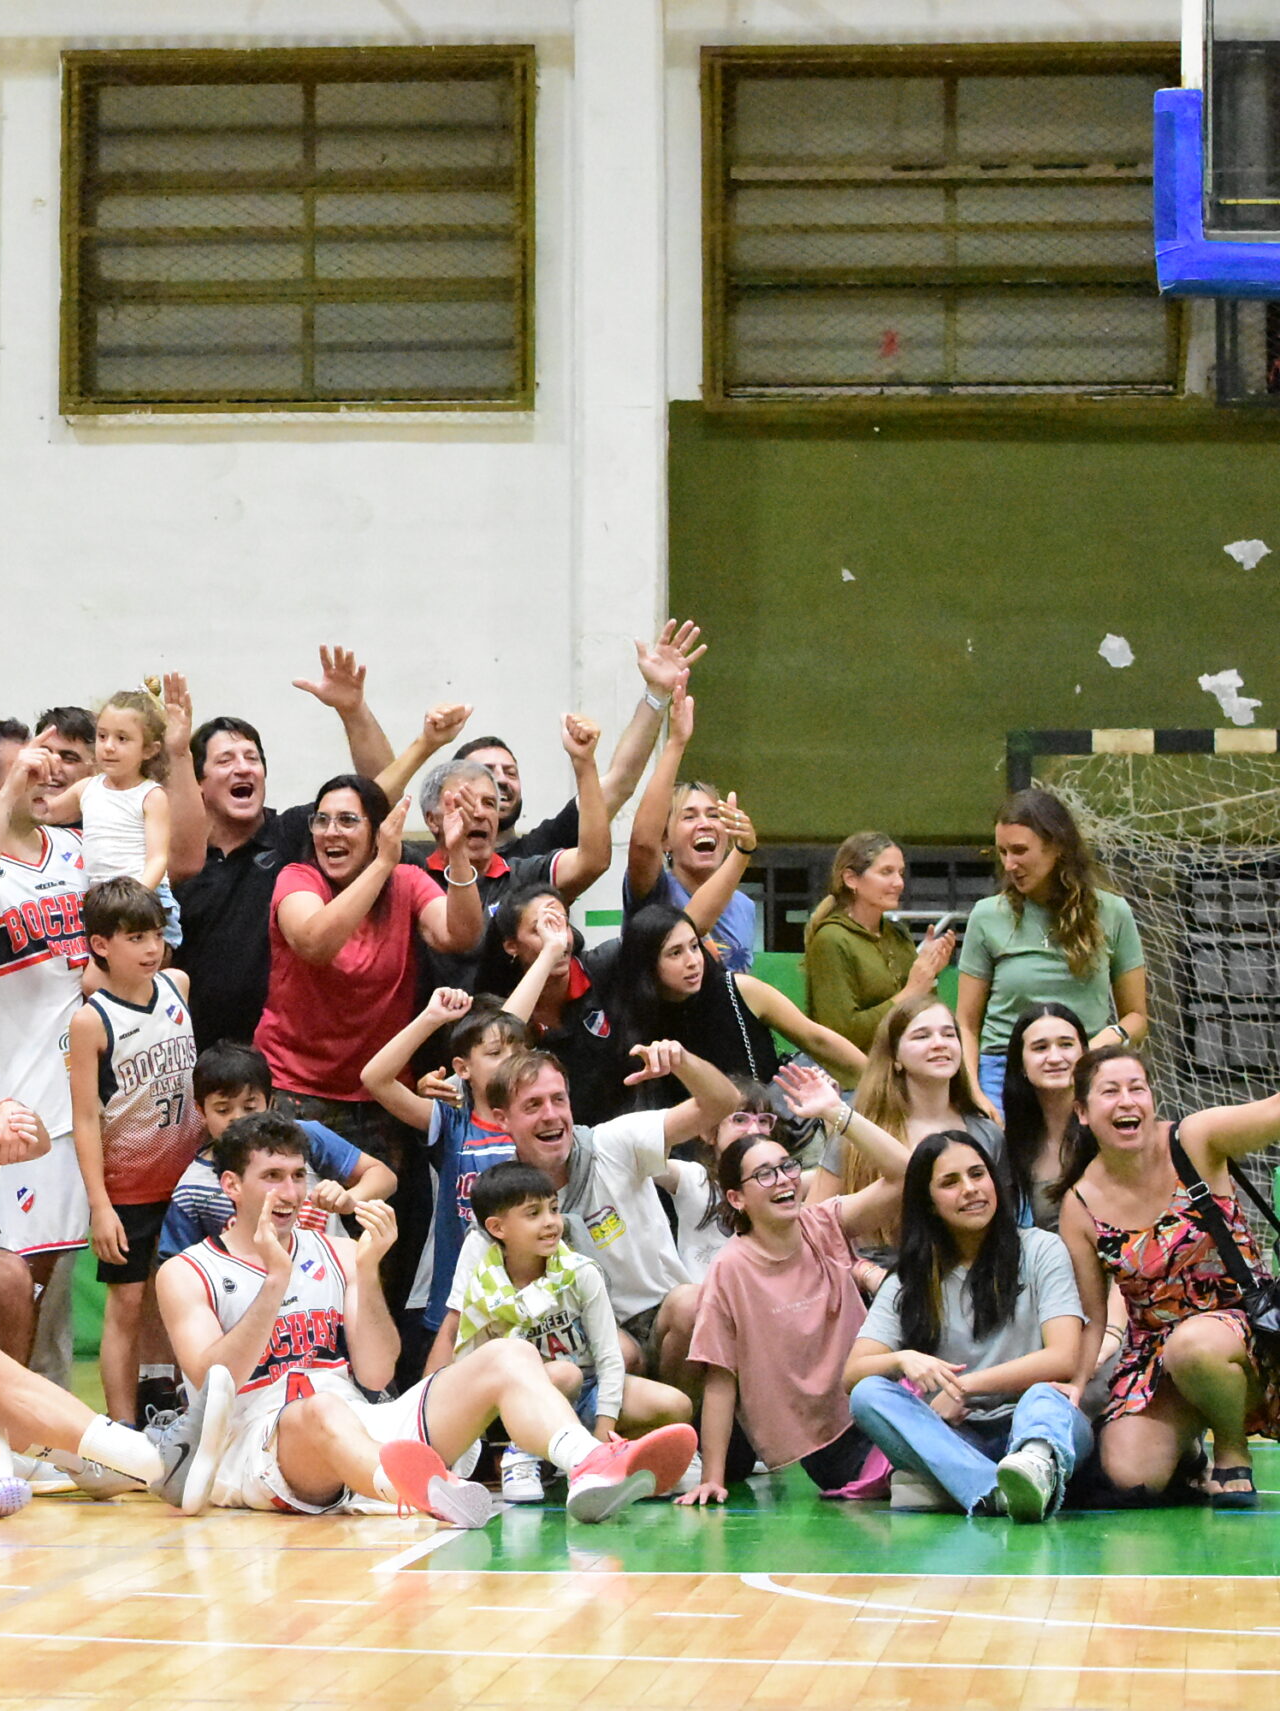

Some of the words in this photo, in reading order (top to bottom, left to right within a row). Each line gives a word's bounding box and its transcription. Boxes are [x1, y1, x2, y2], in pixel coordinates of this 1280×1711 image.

[2, 891, 86, 954] BOCH
[118, 1035, 198, 1096] BOCHAS
[155, 1093, 184, 1129] 37
